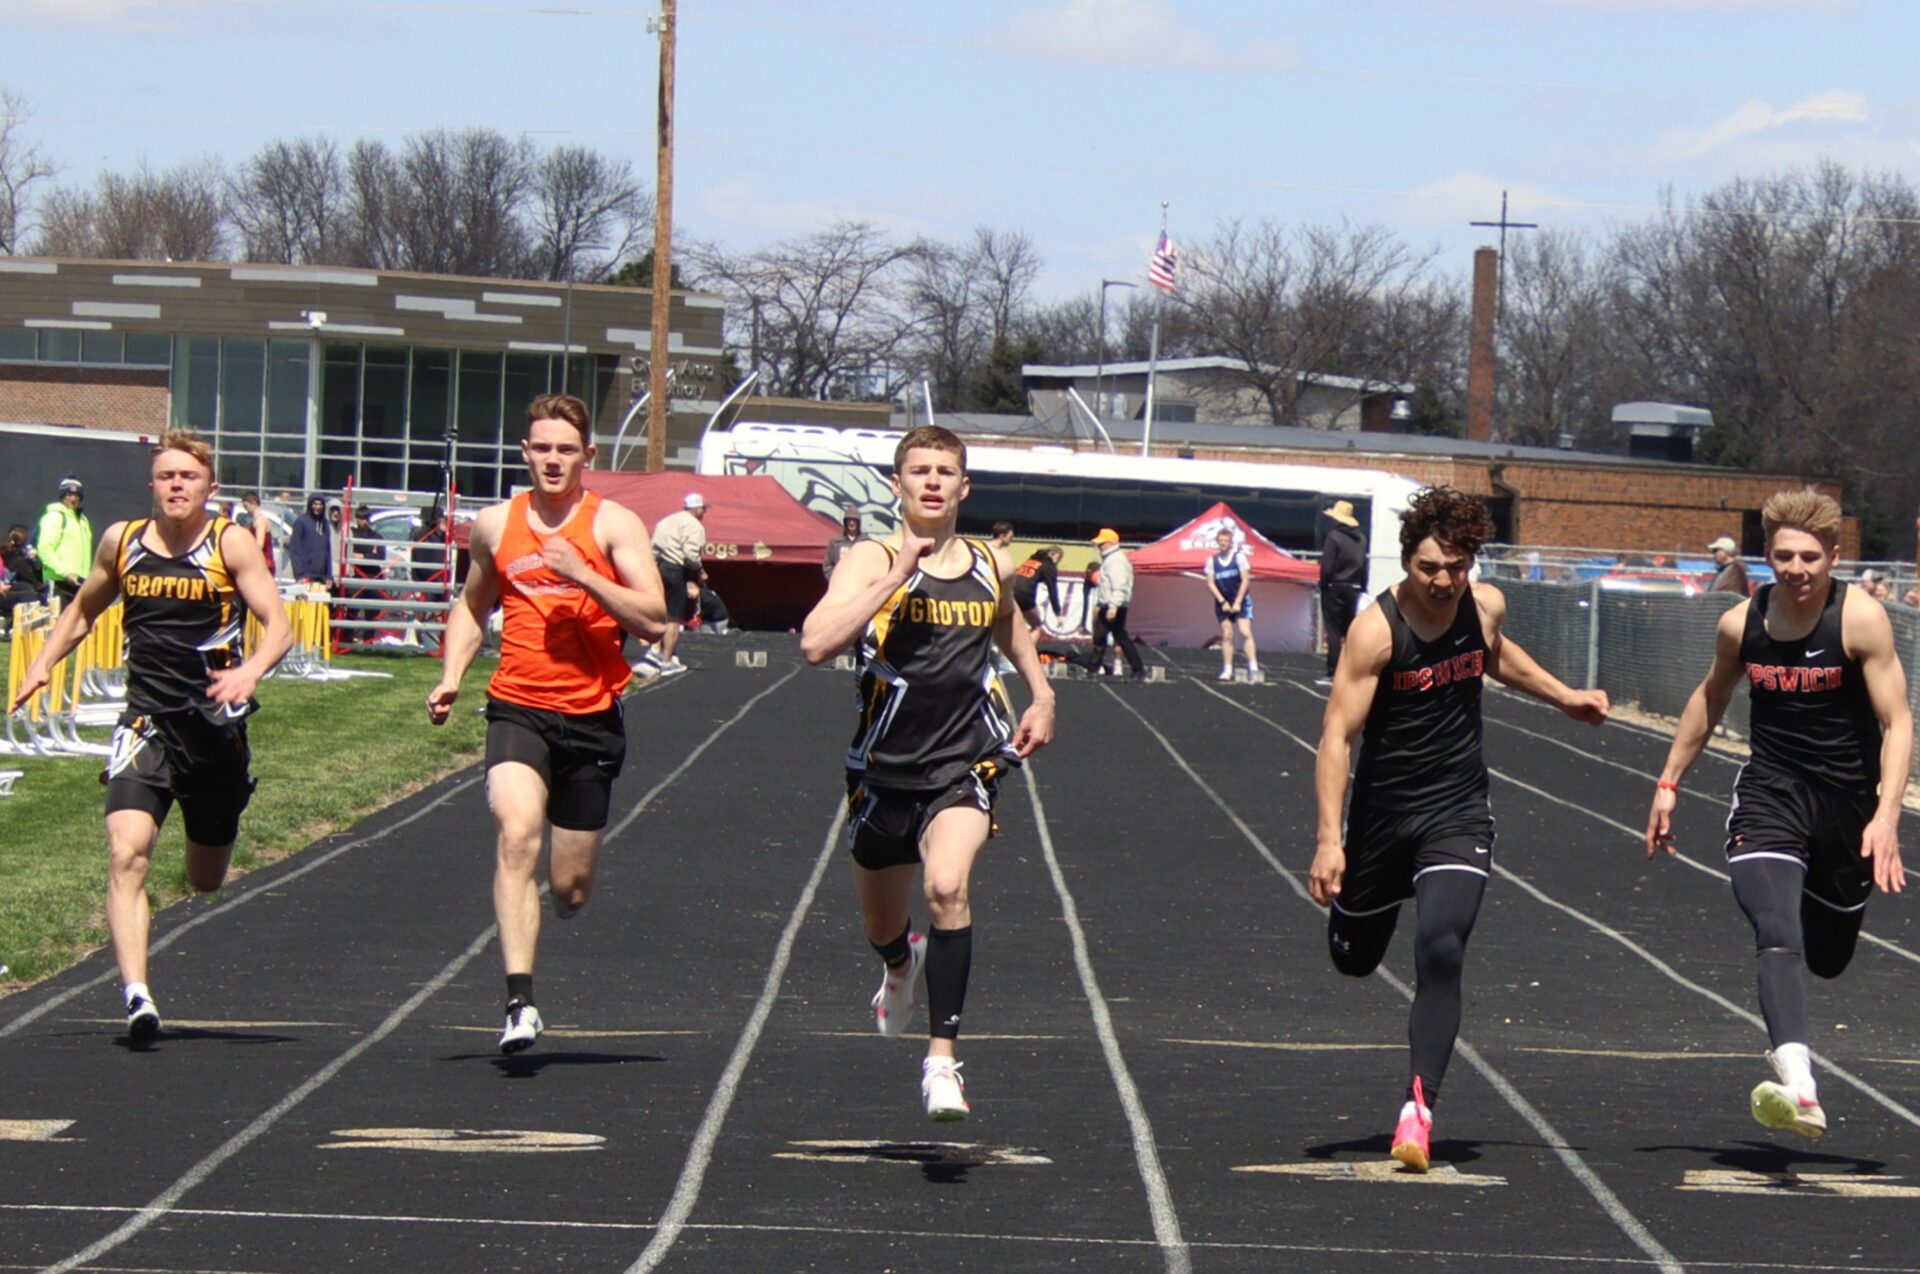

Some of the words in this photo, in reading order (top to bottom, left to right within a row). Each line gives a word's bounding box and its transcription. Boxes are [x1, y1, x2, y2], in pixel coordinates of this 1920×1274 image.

[704, 543, 738, 560] ogs
[127, 574, 205, 600] GROTON
[910, 597, 995, 627] GROTON
[1392, 649, 1484, 692] IPSWICH
